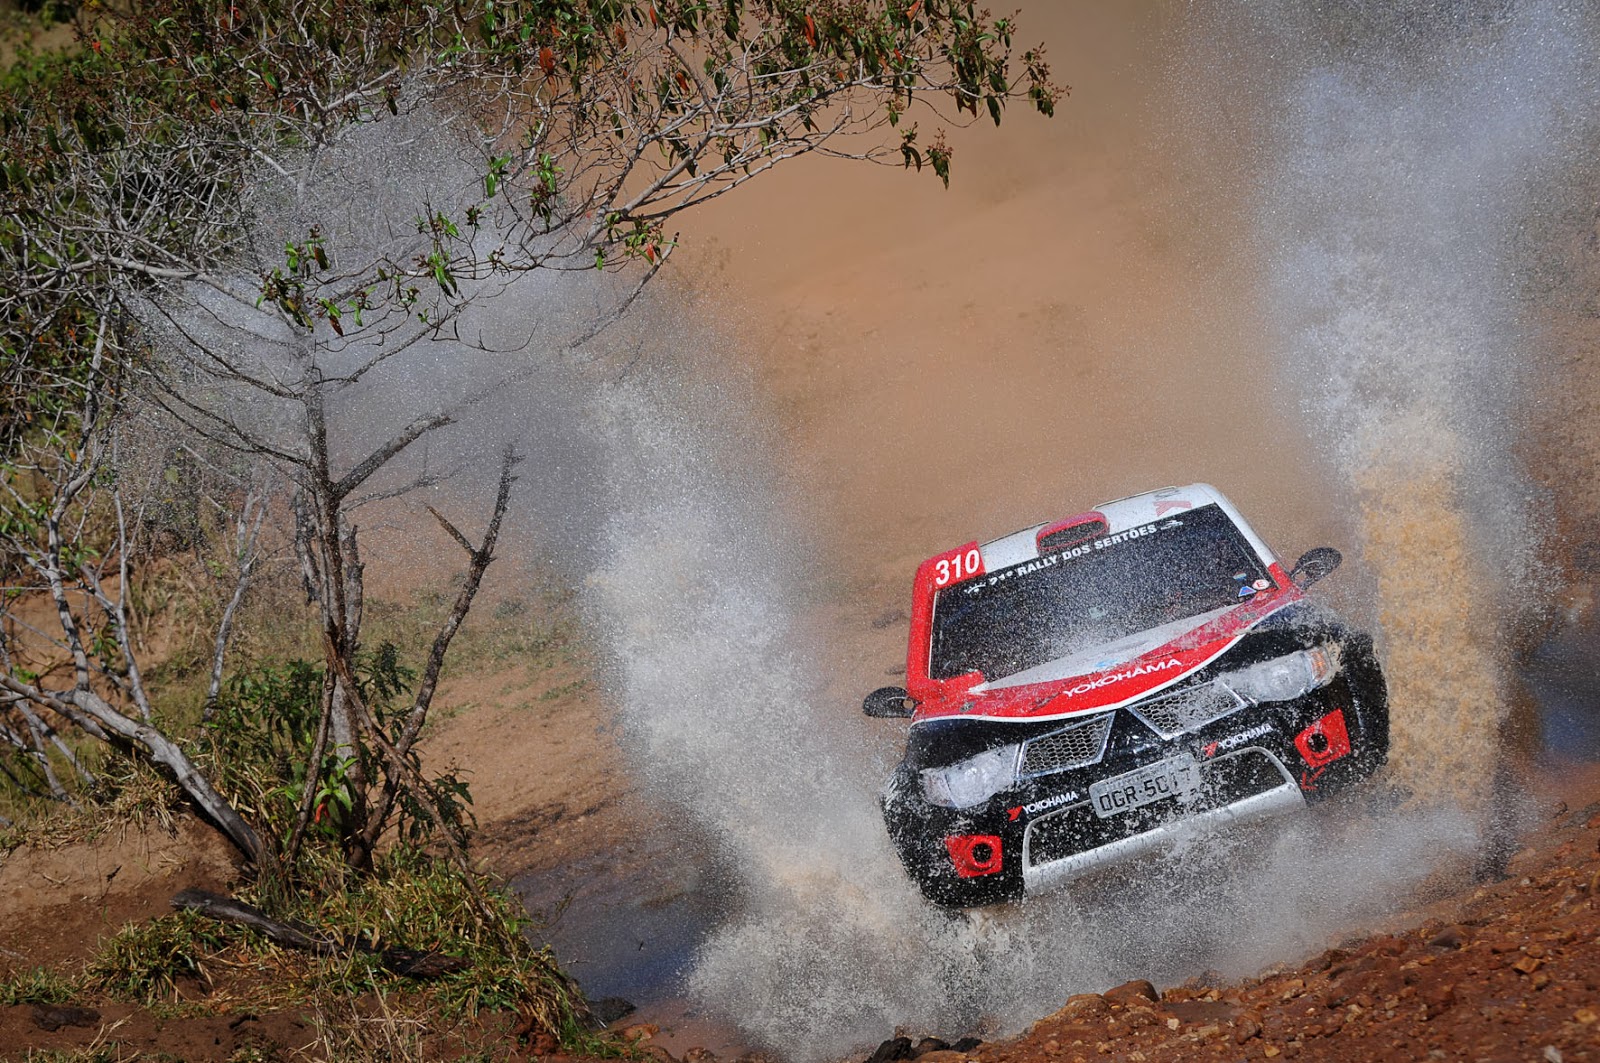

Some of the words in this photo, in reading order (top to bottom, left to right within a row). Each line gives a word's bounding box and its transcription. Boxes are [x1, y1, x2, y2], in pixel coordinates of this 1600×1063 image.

[935, 549, 980, 586] 310
[1017, 554, 1058, 577] RALLY
[1062, 544, 1091, 561] DOS
[1062, 658, 1182, 697] YOKOHAMA
[1219, 722, 1274, 750] YOKOHAMA
[1022, 790, 1079, 815] YOKOHAMA
